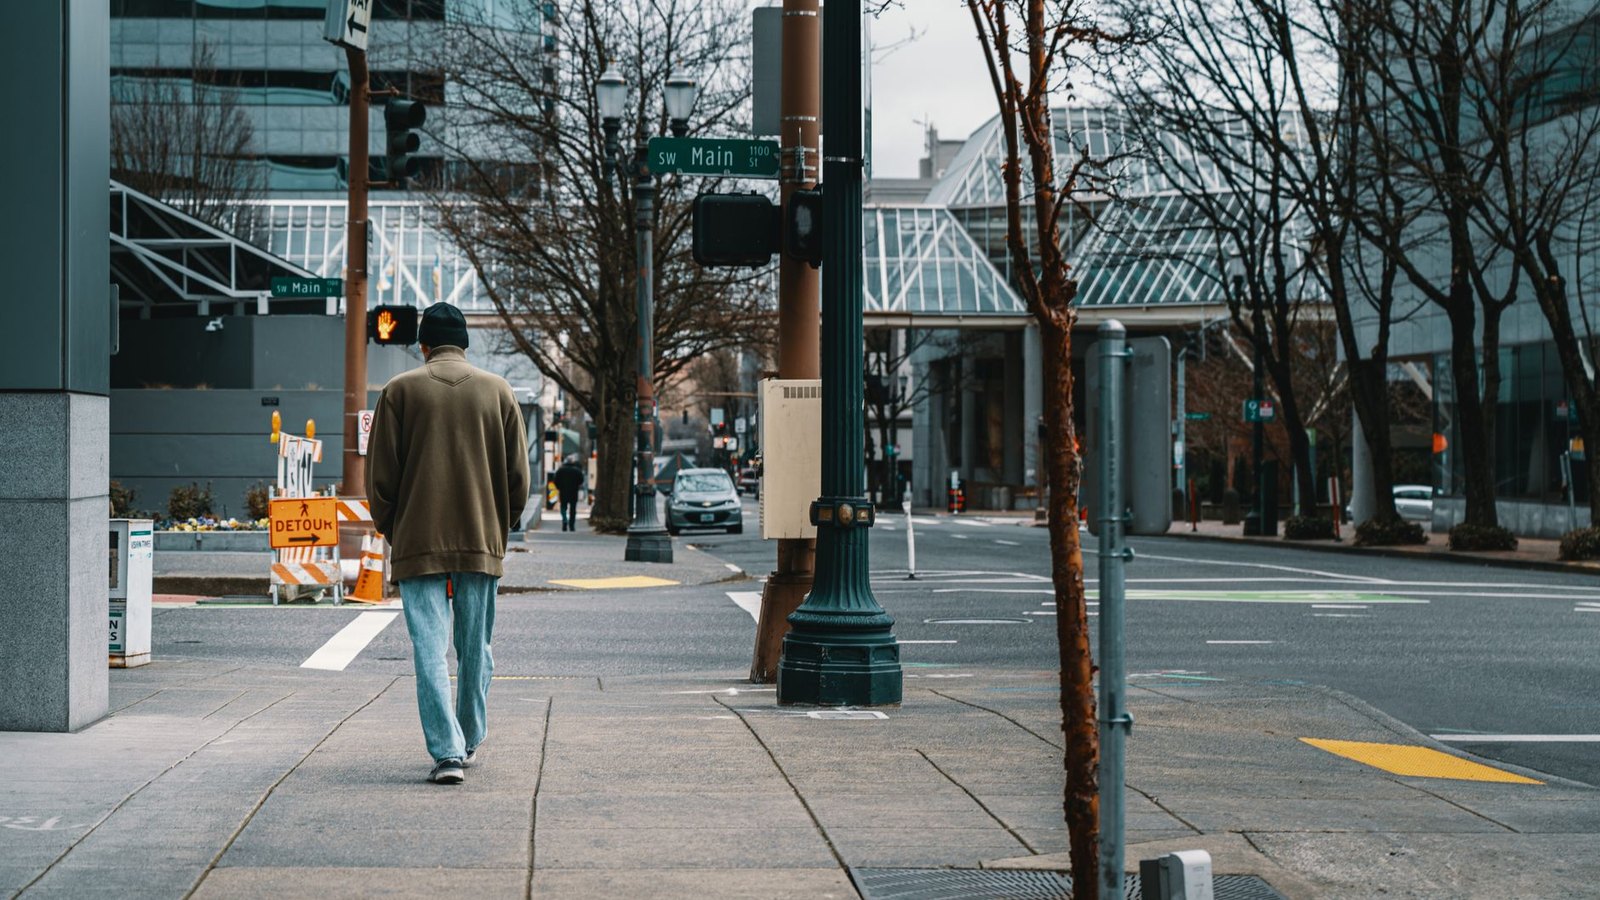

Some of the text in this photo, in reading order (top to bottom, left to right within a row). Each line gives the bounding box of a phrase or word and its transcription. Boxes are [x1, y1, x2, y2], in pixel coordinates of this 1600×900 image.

[658, 145, 770, 167] SW Main 1100
[749, 157, 758, 168] St
[276, 284, 288, 294] SW
[292, 281, 321, 294] Main
[275, 518, 333, 533] DETOUR
